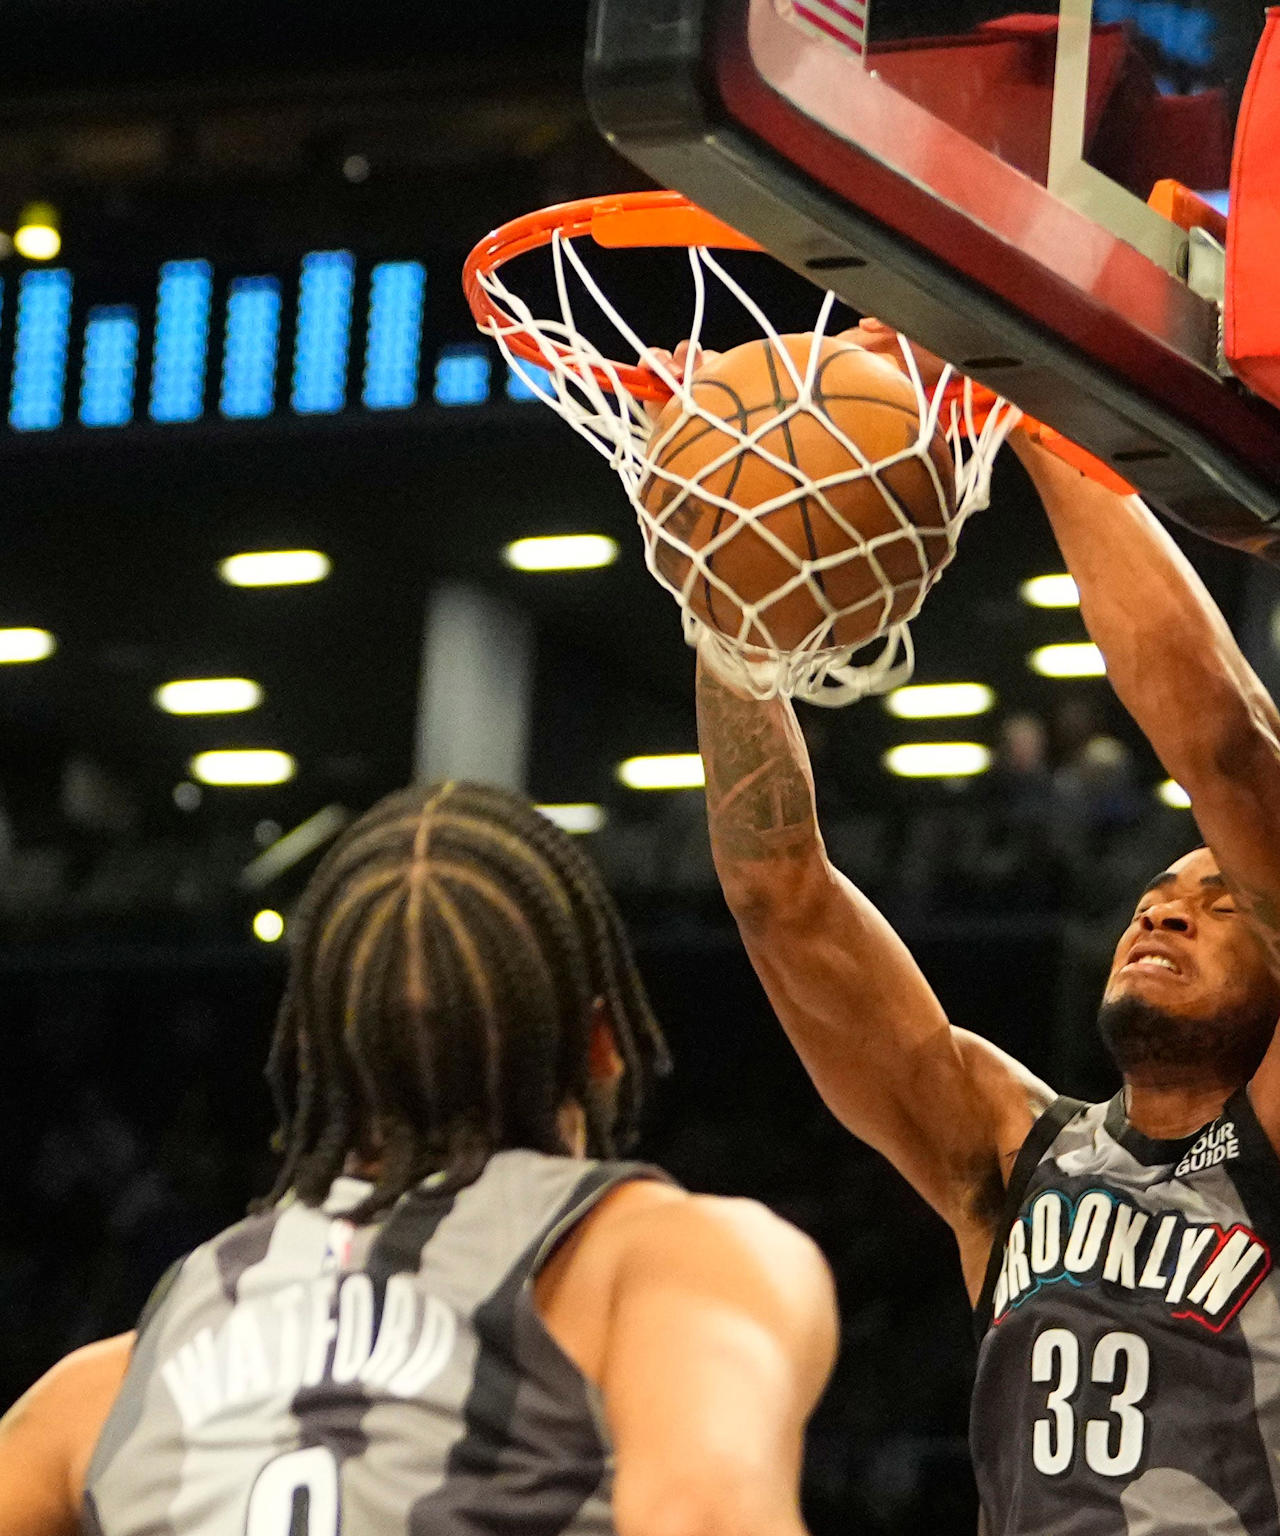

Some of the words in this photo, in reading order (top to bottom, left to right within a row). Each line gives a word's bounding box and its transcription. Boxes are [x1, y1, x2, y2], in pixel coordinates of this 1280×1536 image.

[1174, 1138, 1240, 1177] GUIDE
[1183, 1121, 1235, 1159] OUR
[161, 1272, 456, 1430] WATFORD
[1031, 1328, 1150, 1477] 33
